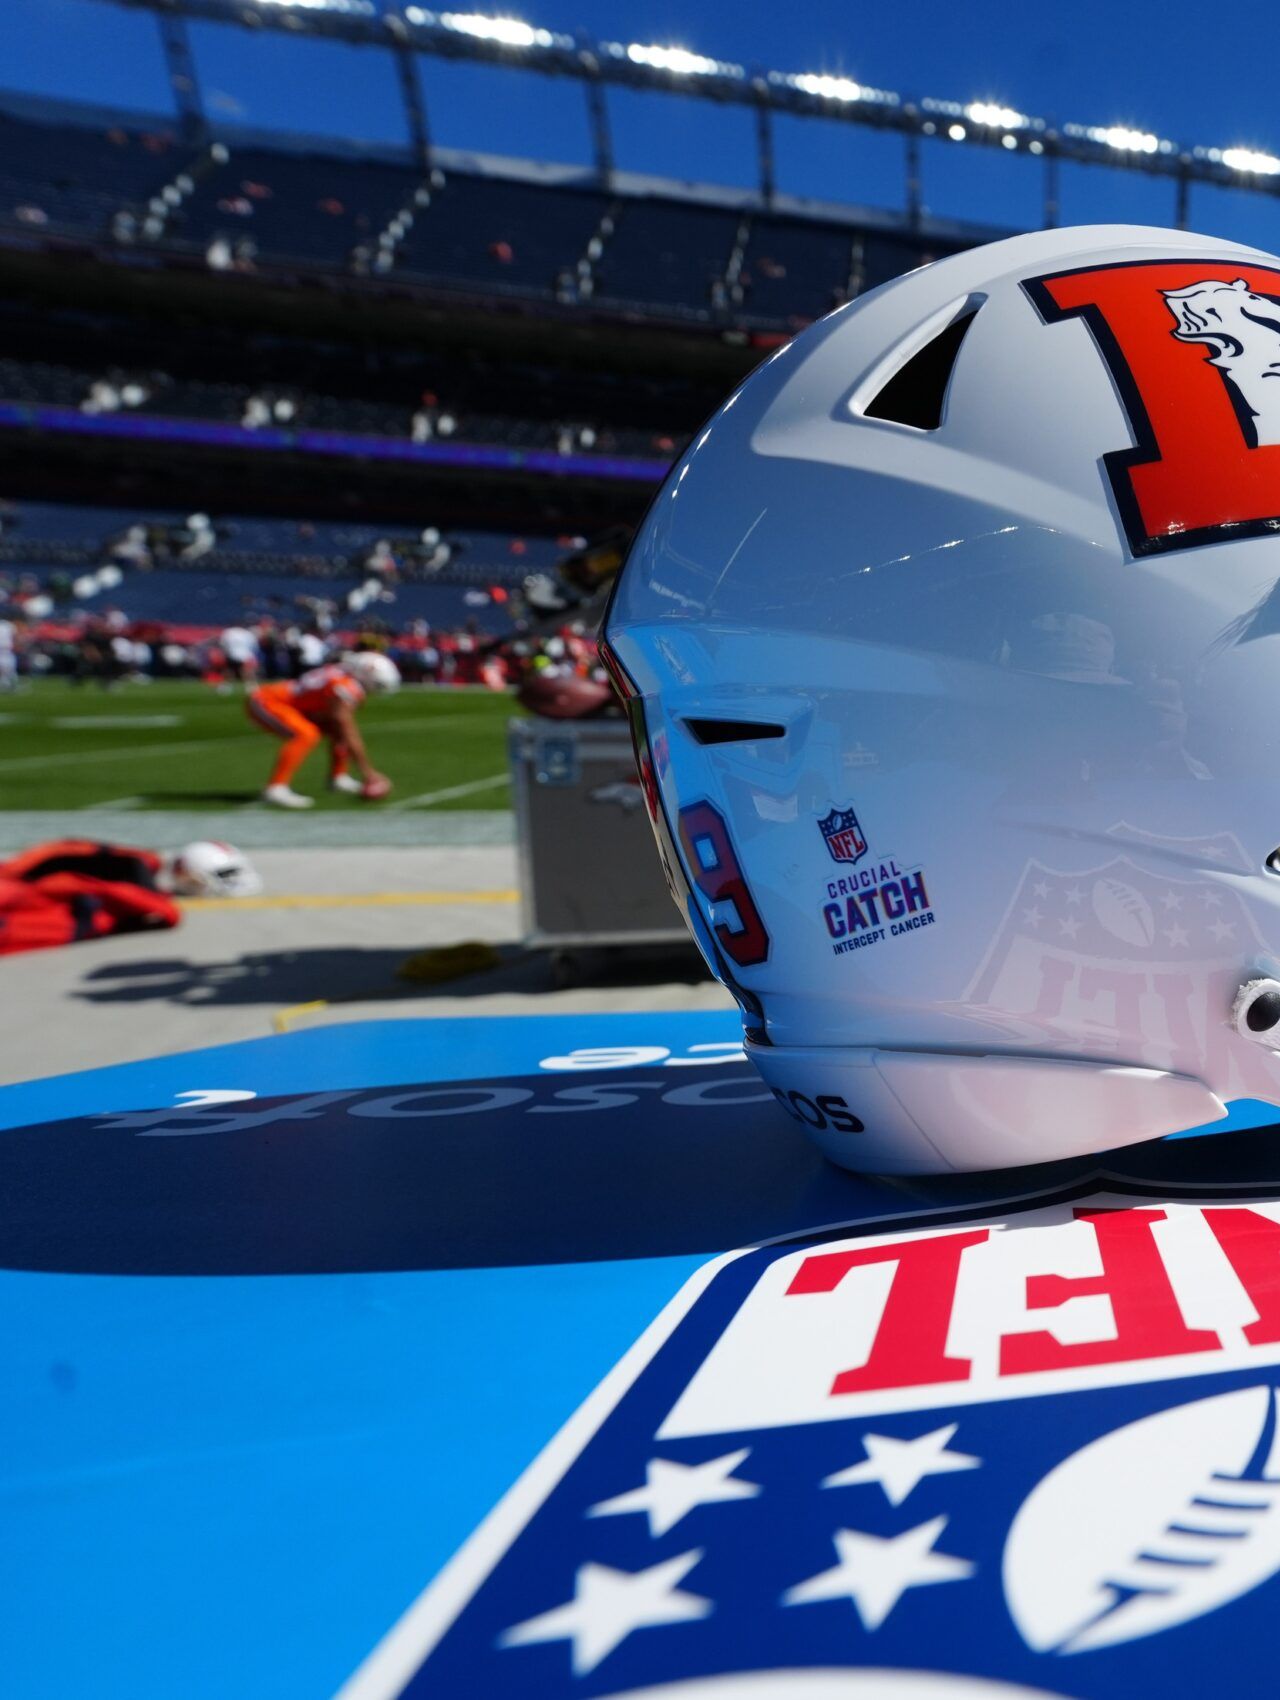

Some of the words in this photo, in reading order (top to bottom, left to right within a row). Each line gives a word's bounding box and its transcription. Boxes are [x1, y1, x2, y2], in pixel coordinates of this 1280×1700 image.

[827, 828, 864, 860] NFL
[678, 799, 770, 967] 9
[827, 861, 902, 899] CRUCIAL
[822, 870, 930, 940] CATCH
[833, 928, 886, 956] INTERCEPT
[890, 911, 936, 937] CANCER
